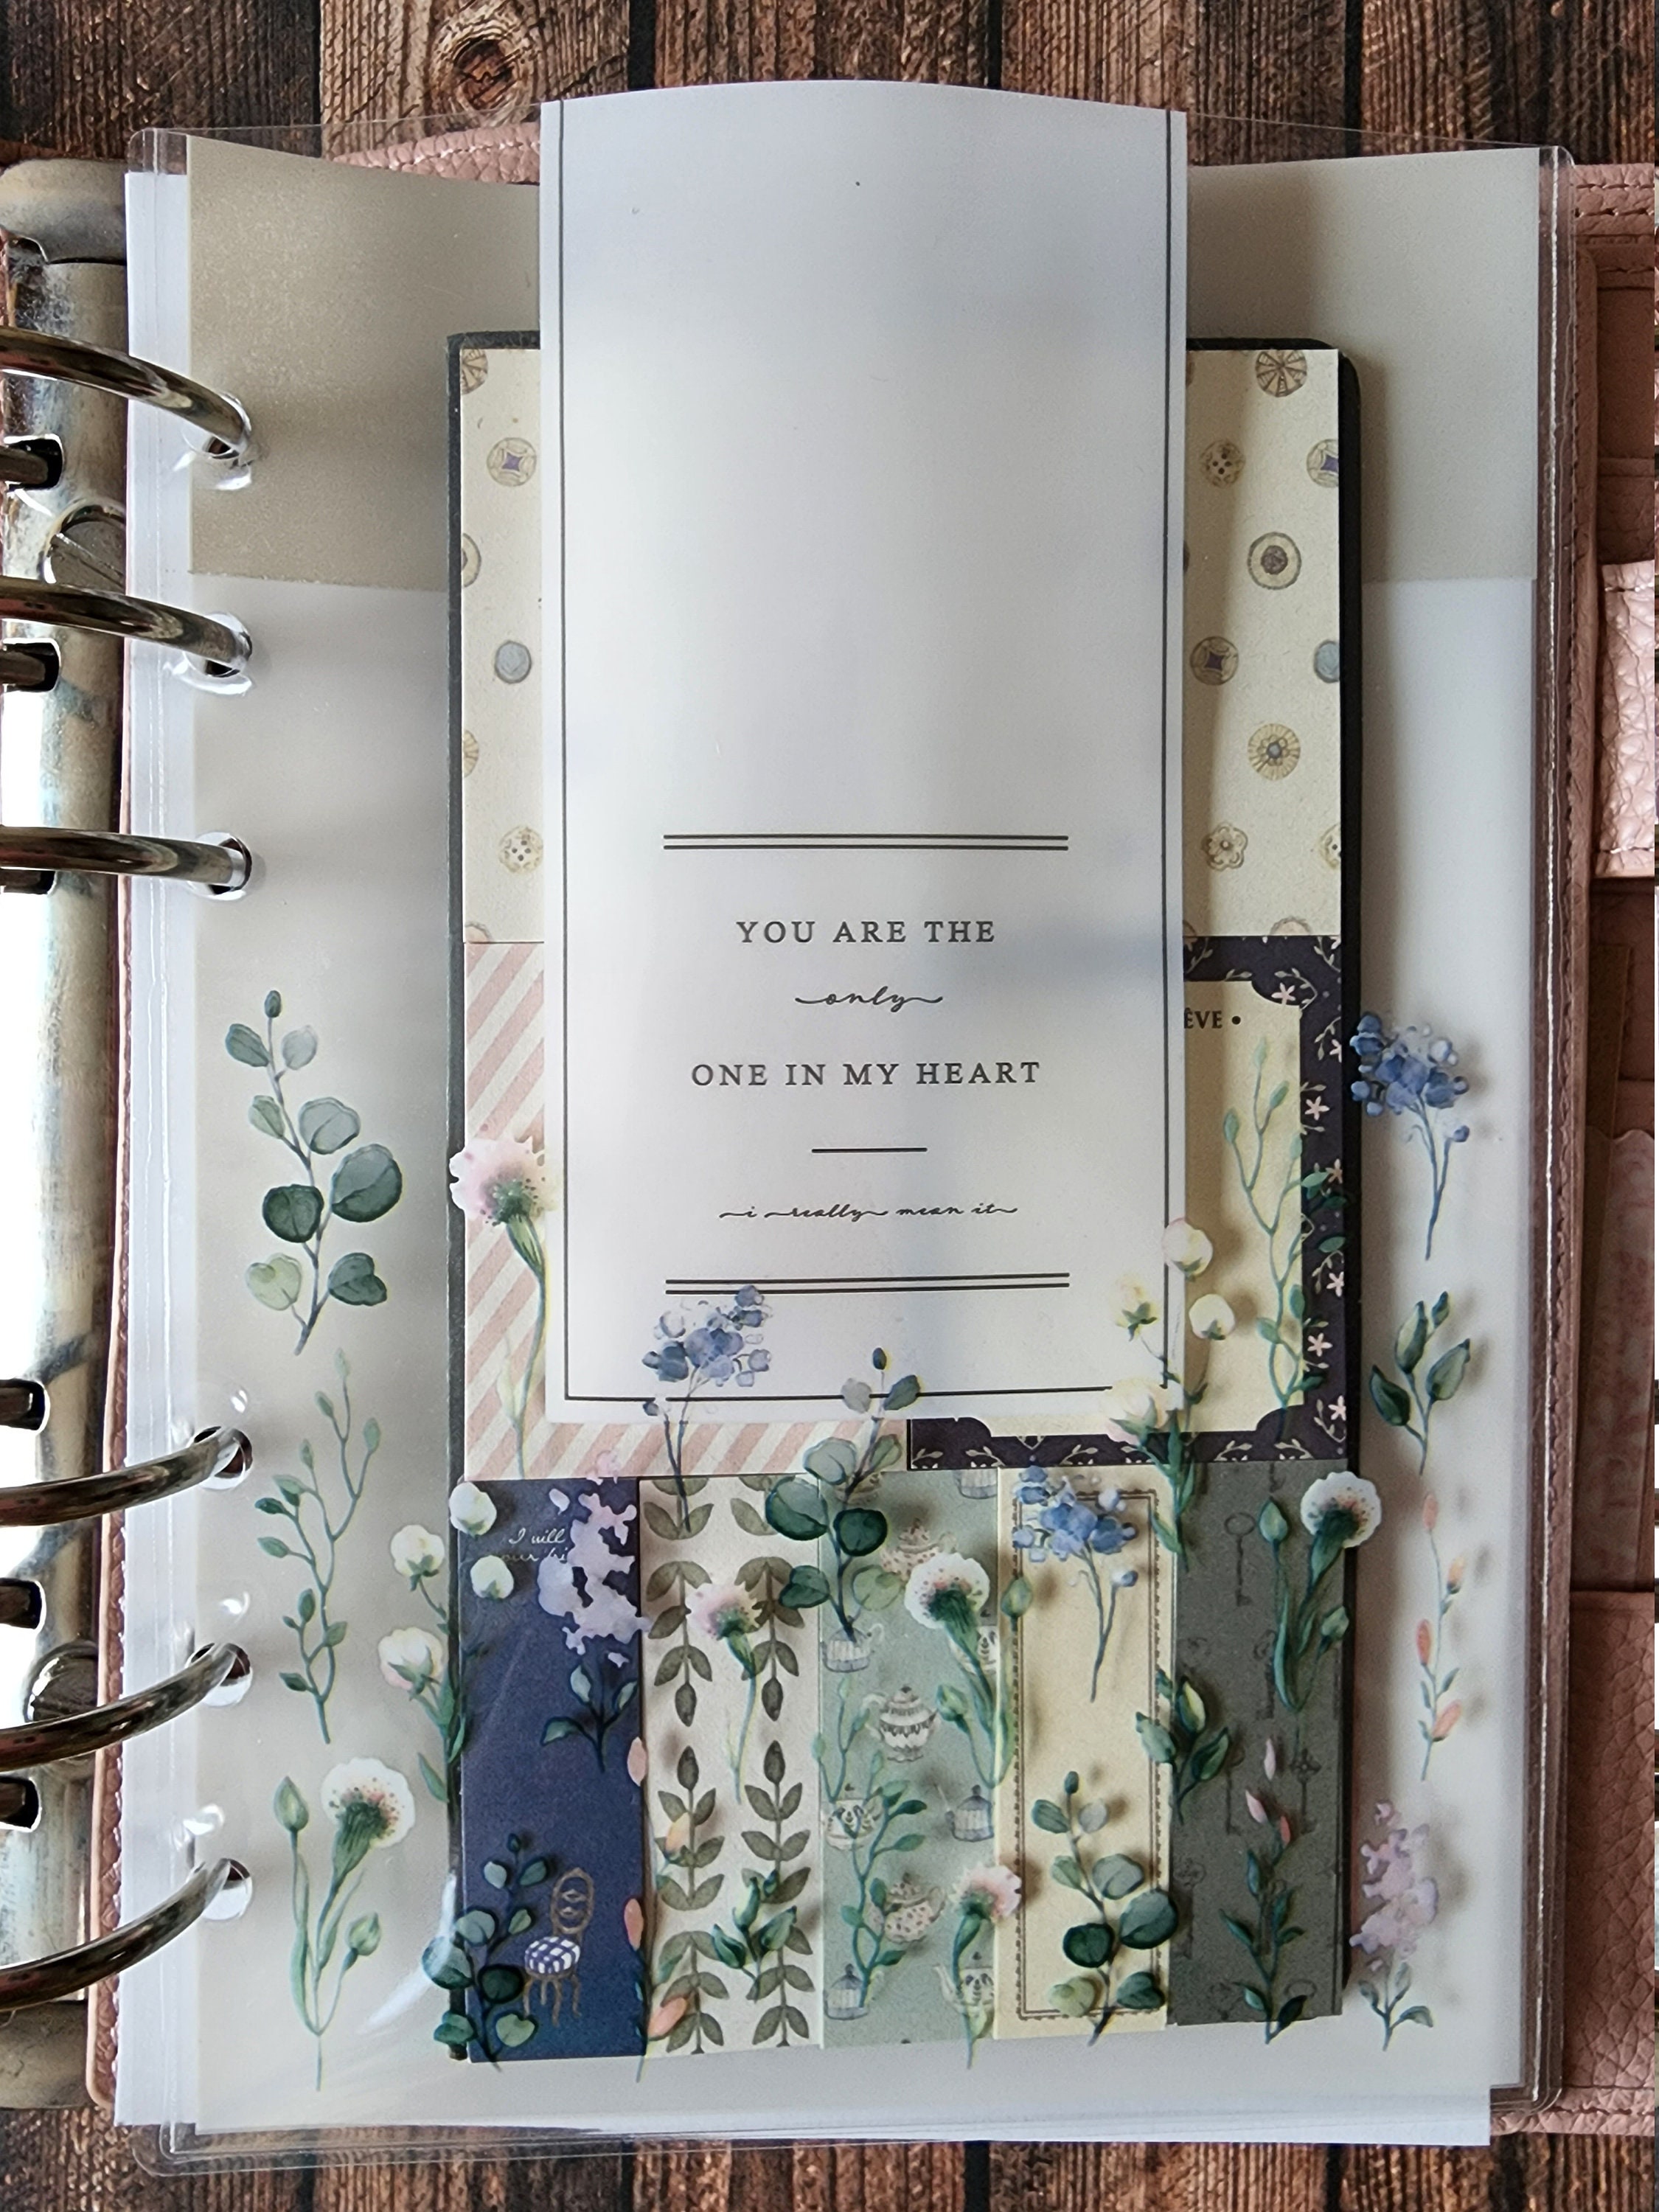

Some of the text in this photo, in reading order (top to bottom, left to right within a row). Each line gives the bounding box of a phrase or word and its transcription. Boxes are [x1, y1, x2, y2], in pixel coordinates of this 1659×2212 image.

[735, 919, 995, 944] YOU ARE THE
[793, 984, 945, 1014] only
[1184, 1007, 1222, 1029] ÊVE
[690, 1060, 1041, 1088] ONE IN MY HEART
[762, 1203, 890, 1223] really
[894, 1206, 965, 1216] mean
[970, 1201, 1019, 1215] it
